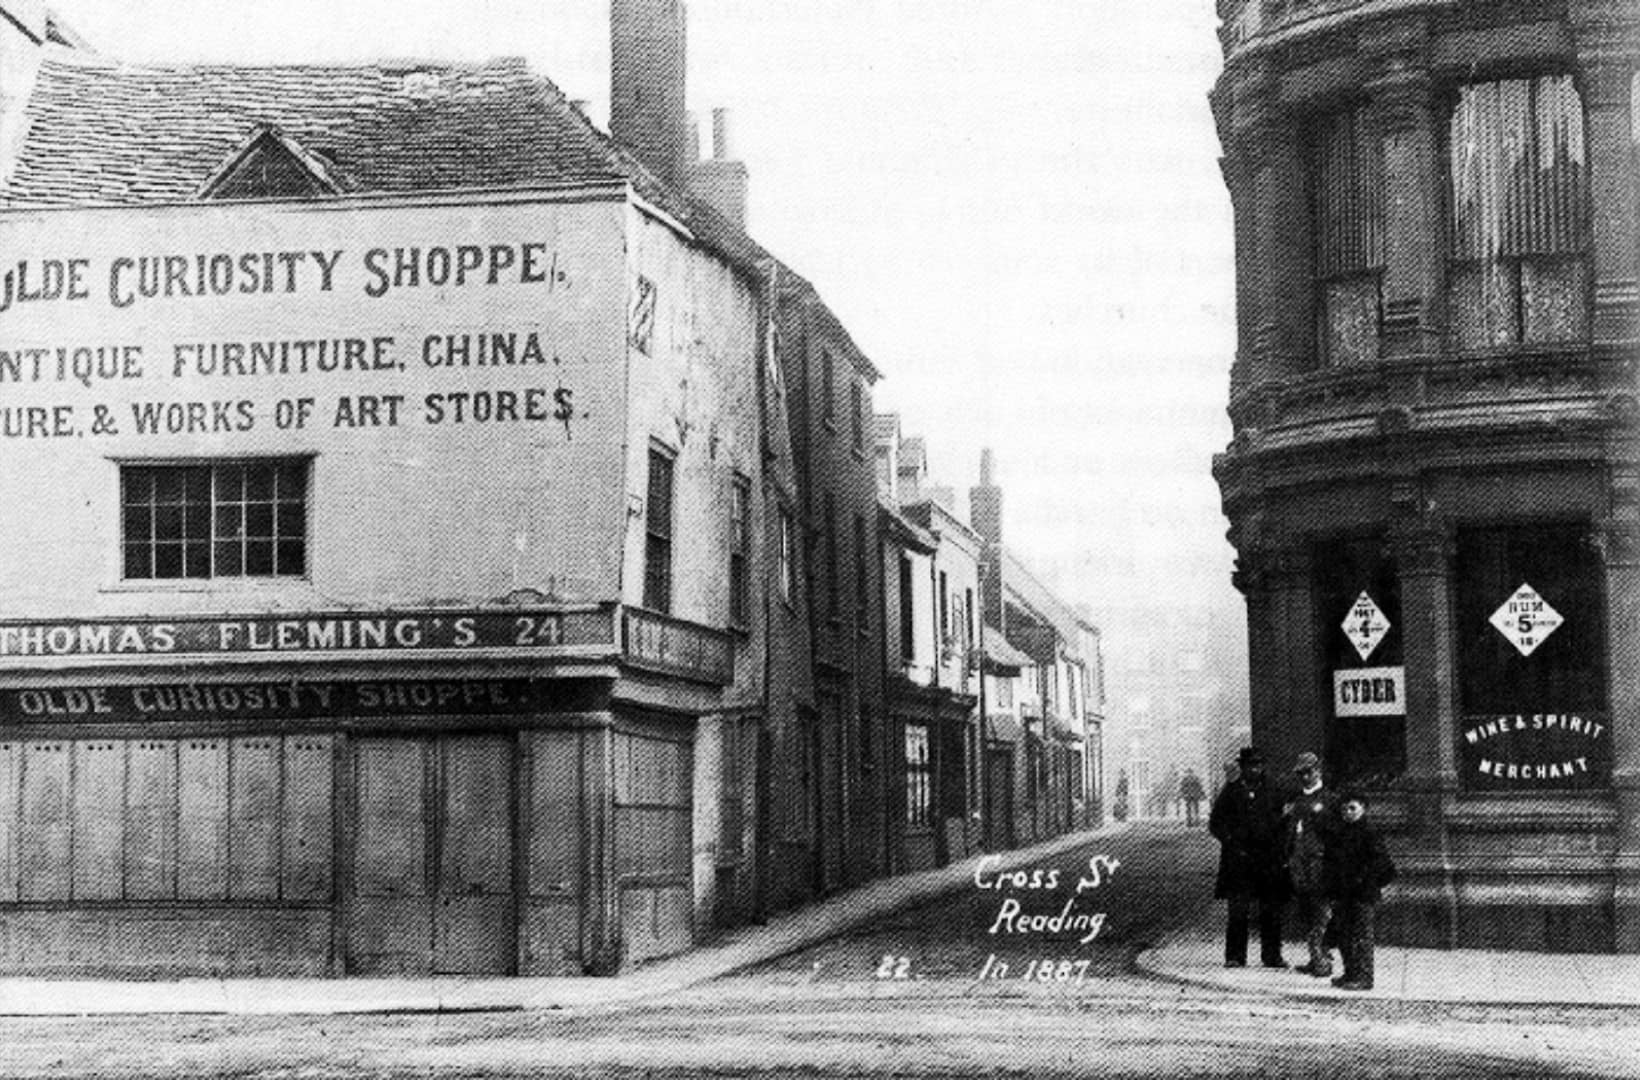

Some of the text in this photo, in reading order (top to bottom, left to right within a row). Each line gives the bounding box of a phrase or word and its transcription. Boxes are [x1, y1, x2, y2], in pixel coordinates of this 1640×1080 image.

[108, 250, 343, 308] CURIOSITY
[91, 404, 119, 435] &
[131, 400, 255, 434] WORKS
[275, 397, 315, 430] OF
[333, 394, 404, 427] ART
[0, 616, 560, 653] THOMAS FLEMING'S 24
[20, 689, 112, 714] OLDE
[132, 684, 334, 713] CURIOSITY
[1341, 678, 1397, 704] CYDER
[1465, 714, 1604, 744] WINE & SPIRIT
[1479, 756, 1588, 779] MERCHANT
